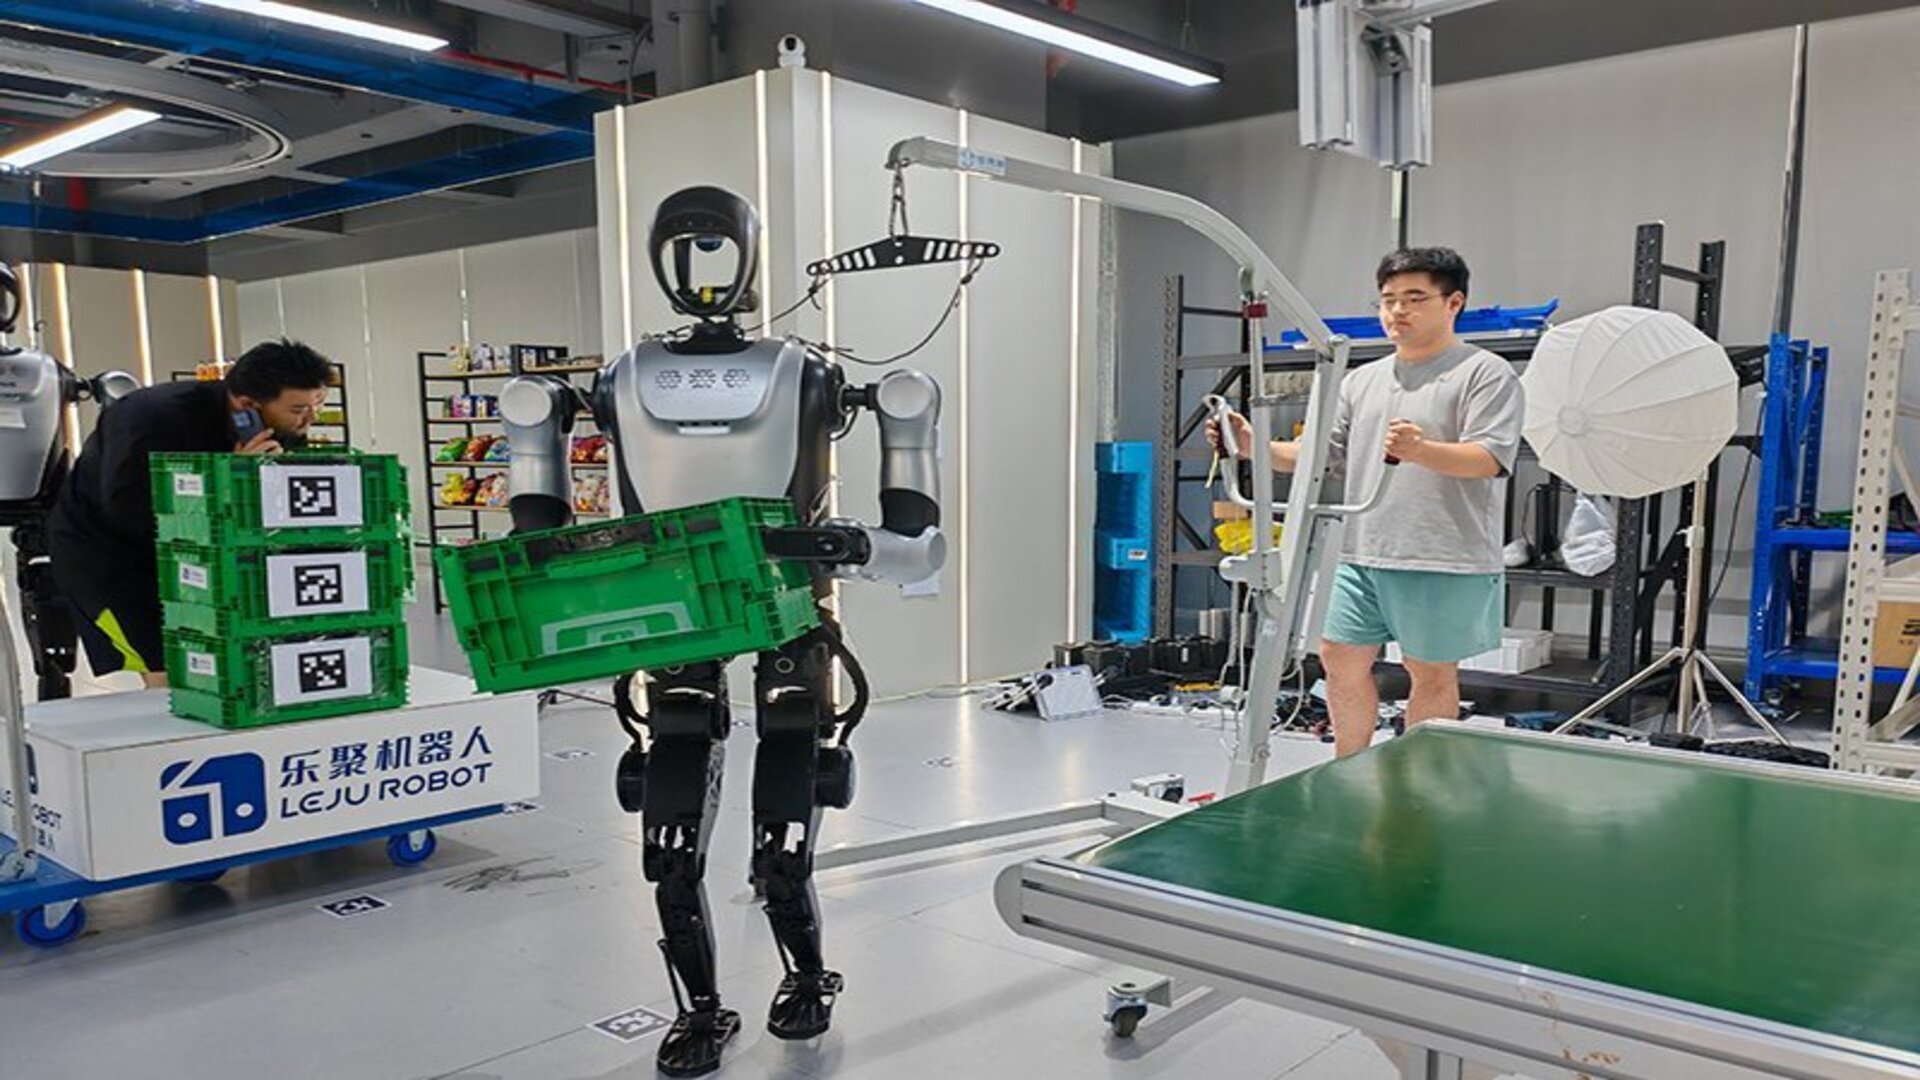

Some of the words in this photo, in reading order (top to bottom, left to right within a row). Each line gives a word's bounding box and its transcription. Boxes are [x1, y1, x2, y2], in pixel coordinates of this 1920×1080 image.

[280, 726, 492, 788] 乐聚机器人
[281, 783, 370, 819] LEJU
[378, 762, 493, 801] ROBOT
